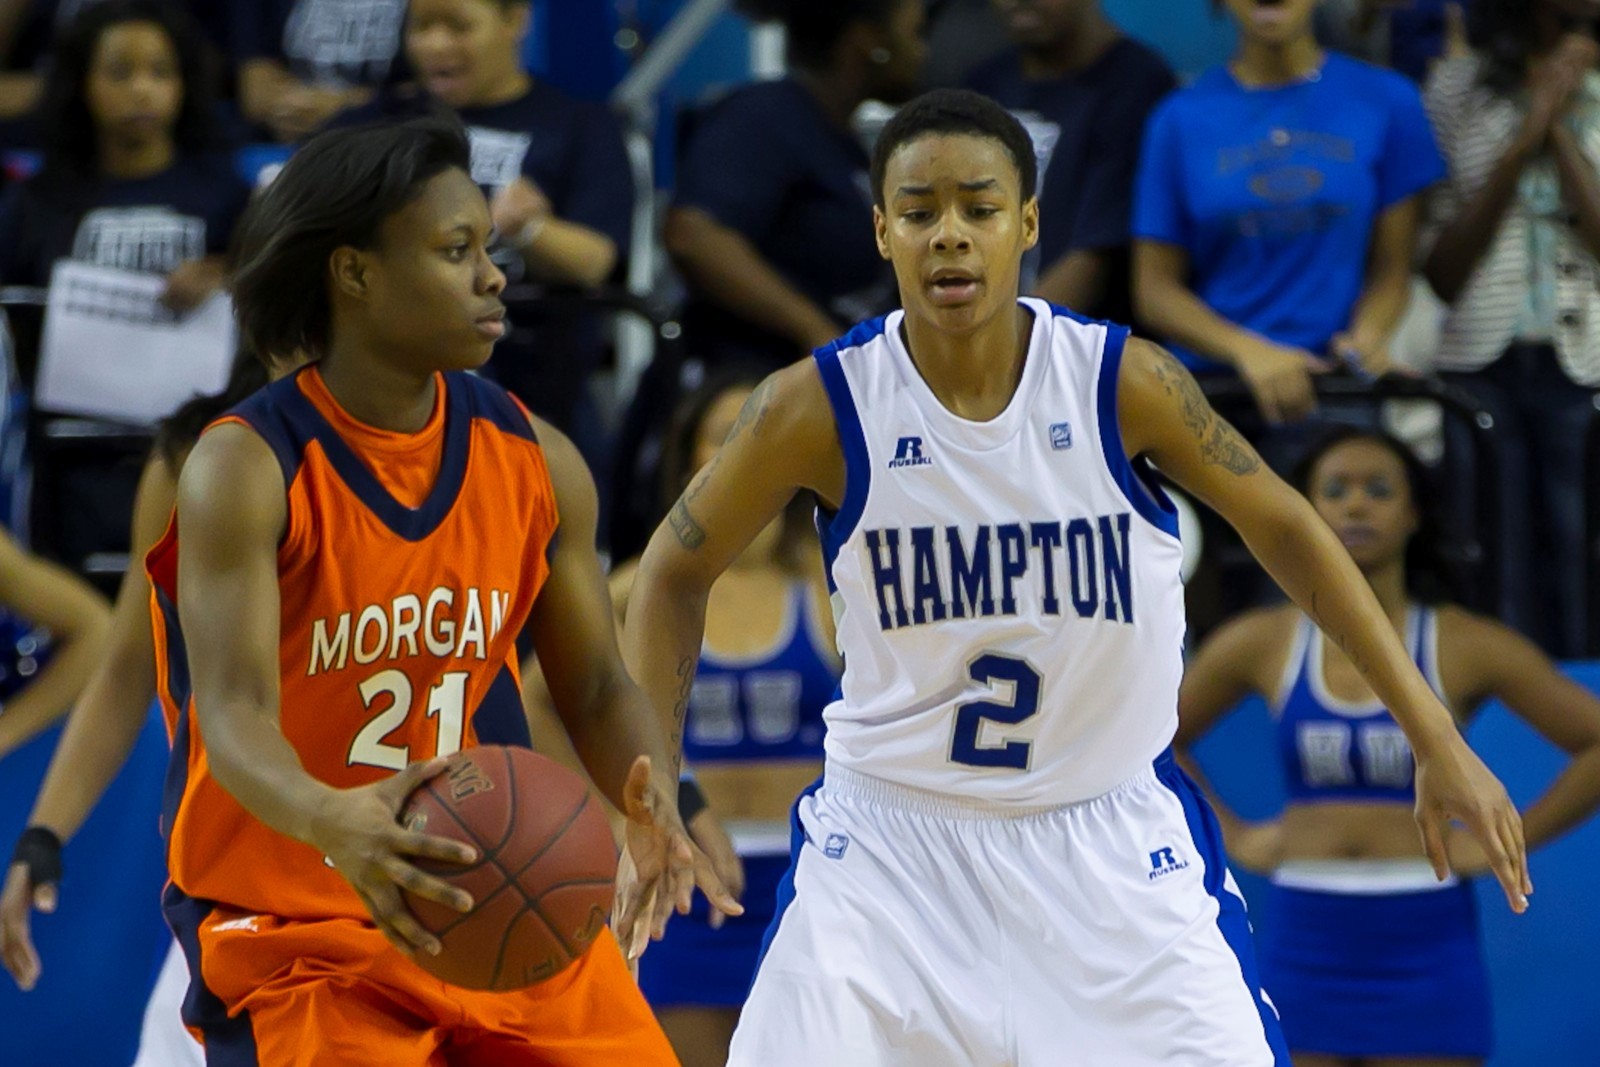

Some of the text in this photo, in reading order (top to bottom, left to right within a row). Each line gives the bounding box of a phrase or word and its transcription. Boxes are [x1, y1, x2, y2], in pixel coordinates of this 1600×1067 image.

[864, 512, 1135, 631] HAMPTON
[307, 585, 510, 677] MORGAN
[347, 668, 470, 771] 21
[946, 649, 1044, 773] 2
